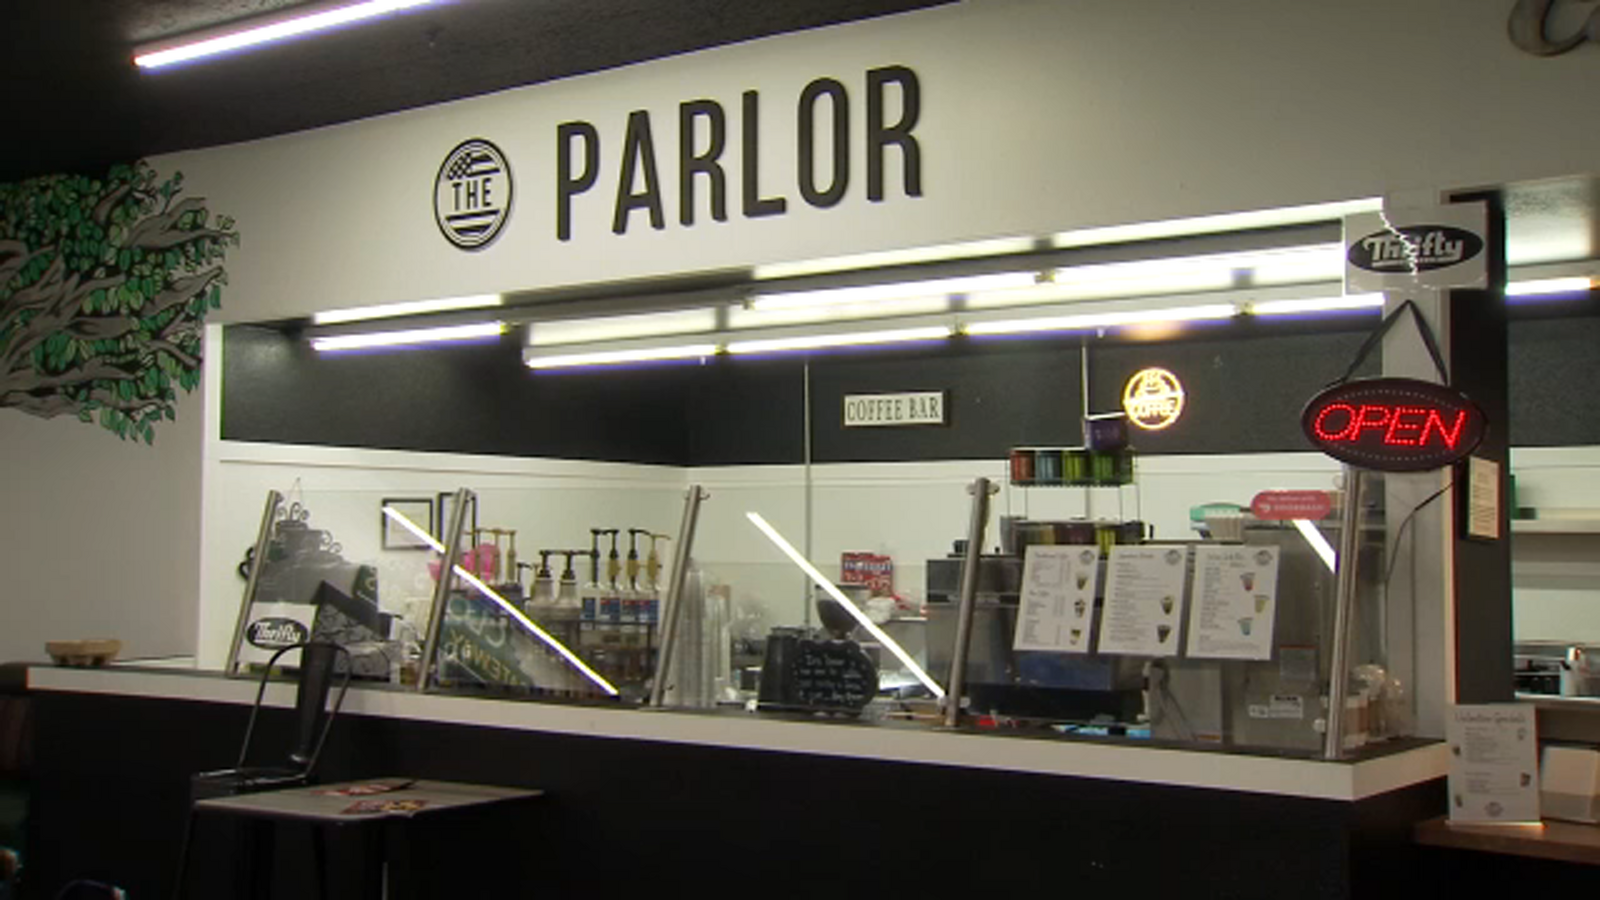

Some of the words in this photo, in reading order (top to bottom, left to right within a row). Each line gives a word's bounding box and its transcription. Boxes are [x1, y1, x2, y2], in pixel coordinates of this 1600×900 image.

[556, 64, 924, 241] PARLOR
[451, 177, 493, 211] THE
[846, 399, 903, 421] COFFEE
[908, 397, 940, 420] BAR
[1313, 402, 1467, 451] OPEN
